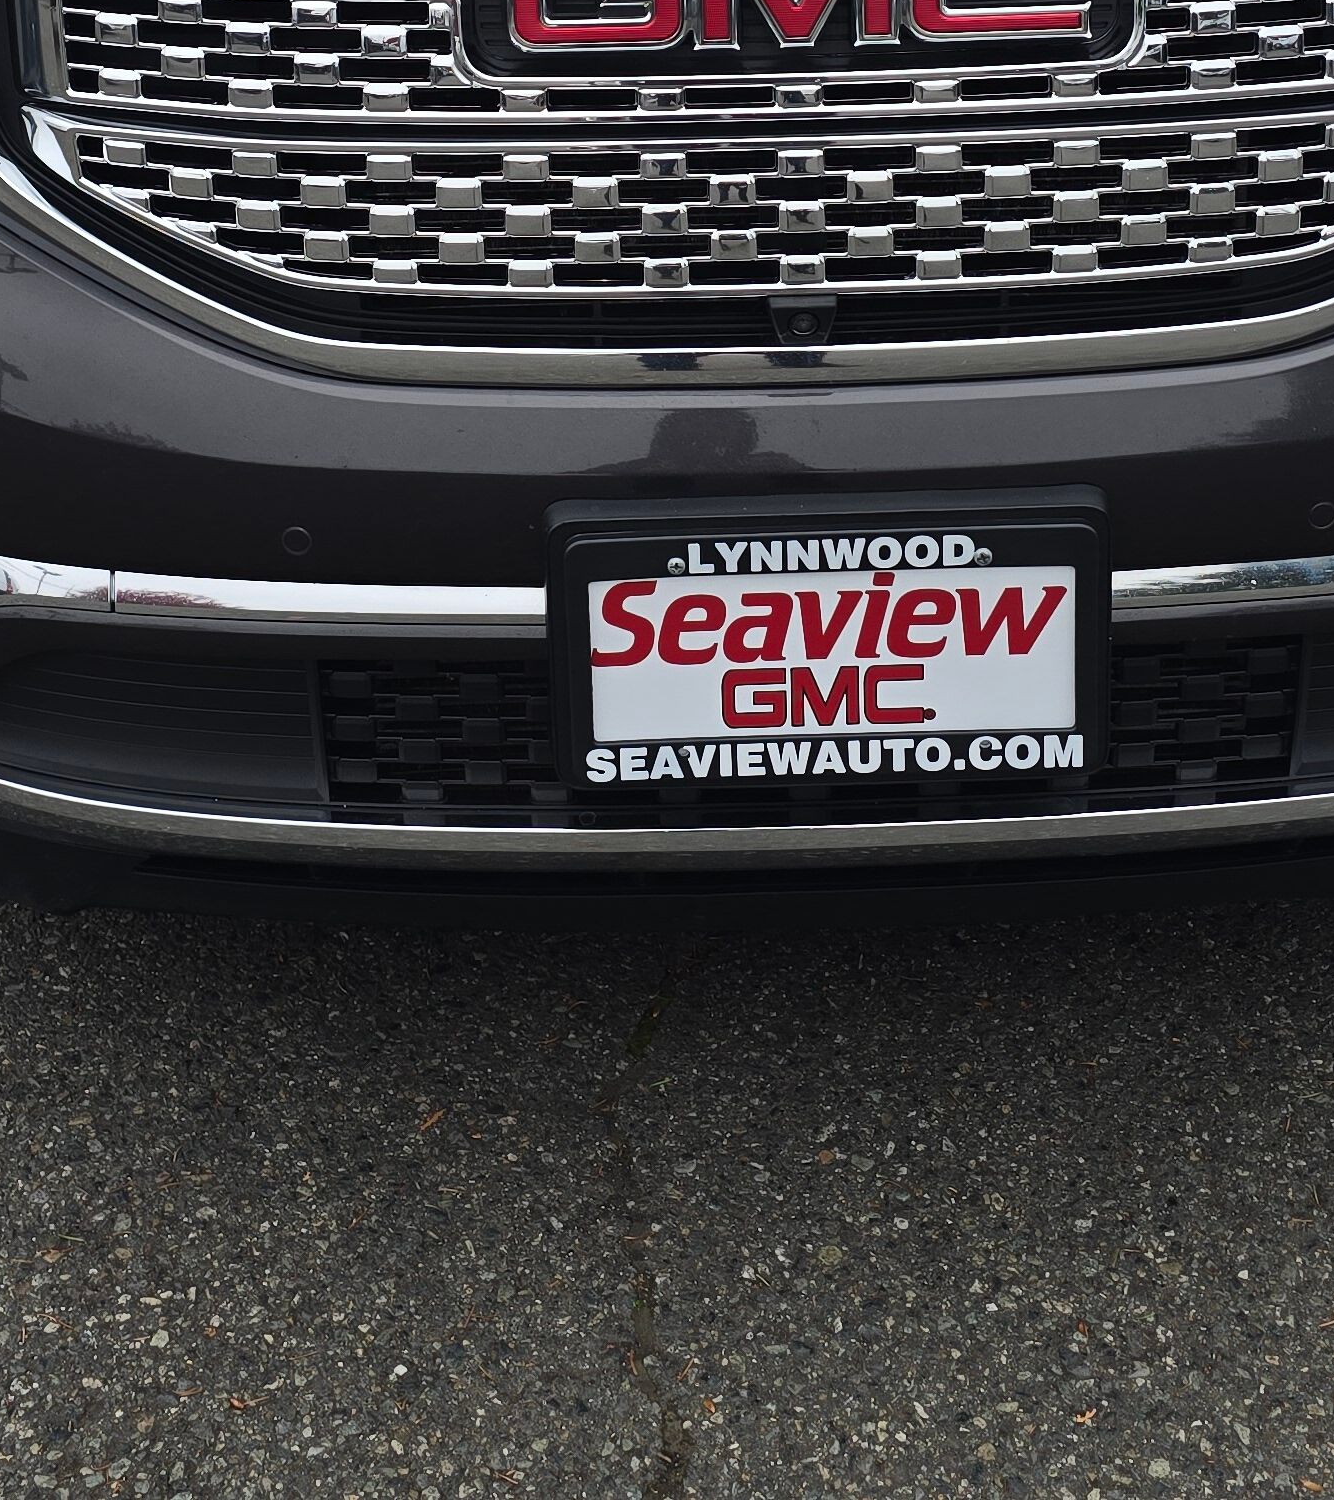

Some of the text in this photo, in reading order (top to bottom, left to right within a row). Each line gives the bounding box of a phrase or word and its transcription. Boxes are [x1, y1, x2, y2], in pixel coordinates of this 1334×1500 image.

[687, 534, 976, 575] LYNNWOOD
[590, 572, 1068, 667] Seaview
[721, 664, 927, 729] GMC
[586, 734, 1084, 783] SEAVIEWAUTO.COM
